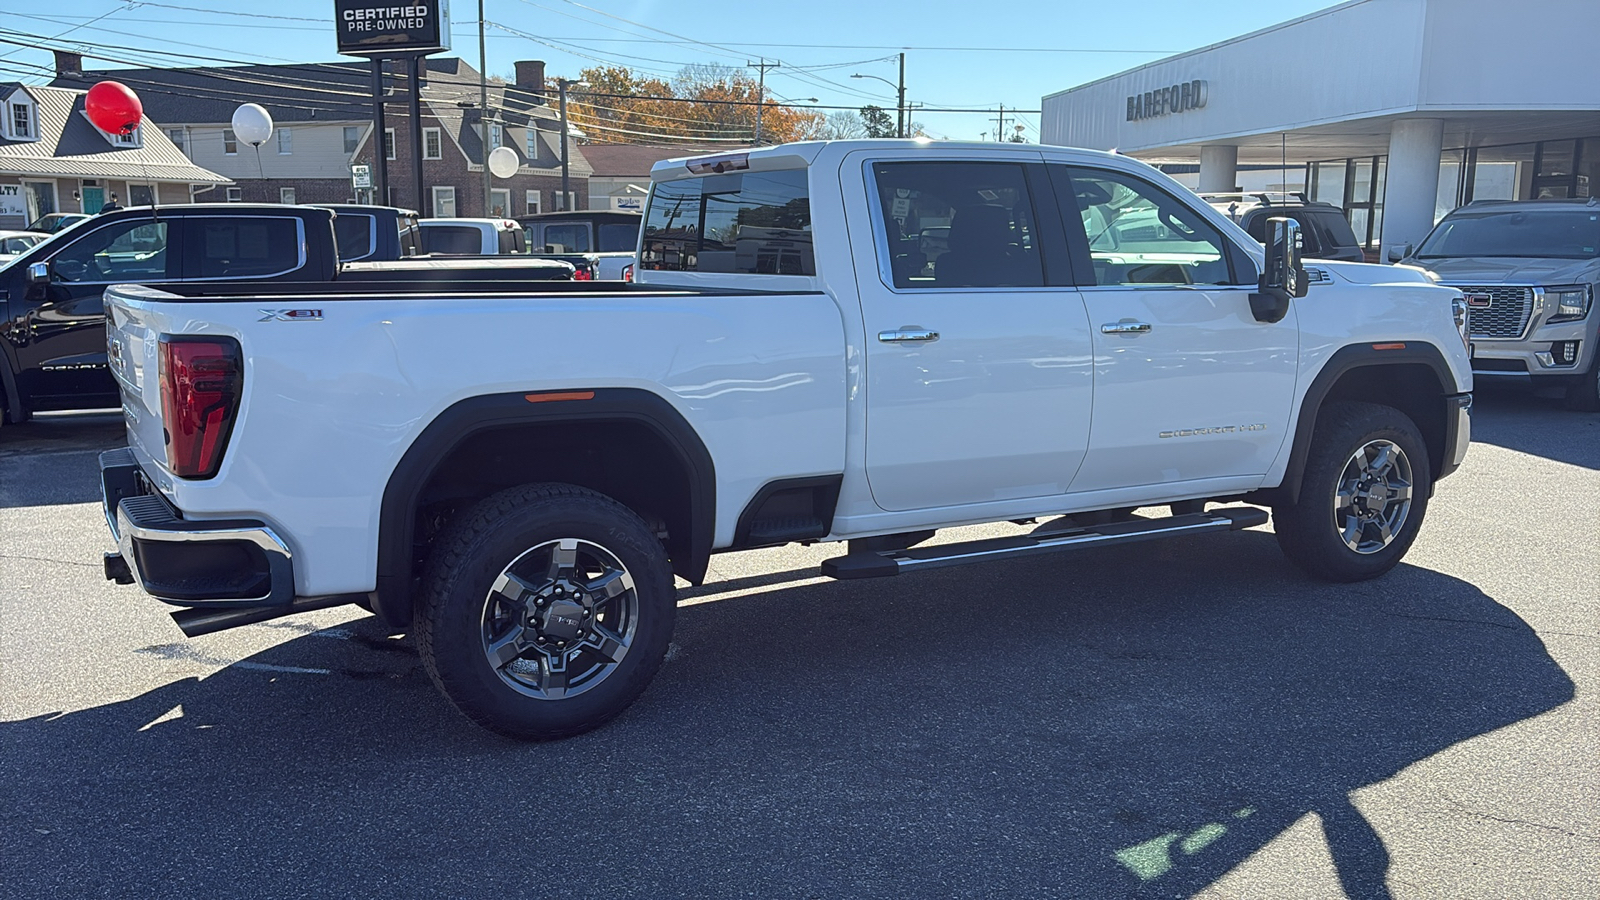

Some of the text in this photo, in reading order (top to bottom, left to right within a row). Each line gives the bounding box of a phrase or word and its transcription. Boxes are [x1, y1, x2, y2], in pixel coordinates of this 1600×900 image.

[343, 5, 428, 21] CERTIFIED
[348, 17, 424, 32] PRE-OWNED
[1126, 79, 1208, 122] BAREFORD
[1159, 426, 1236, 438] SIERRA
